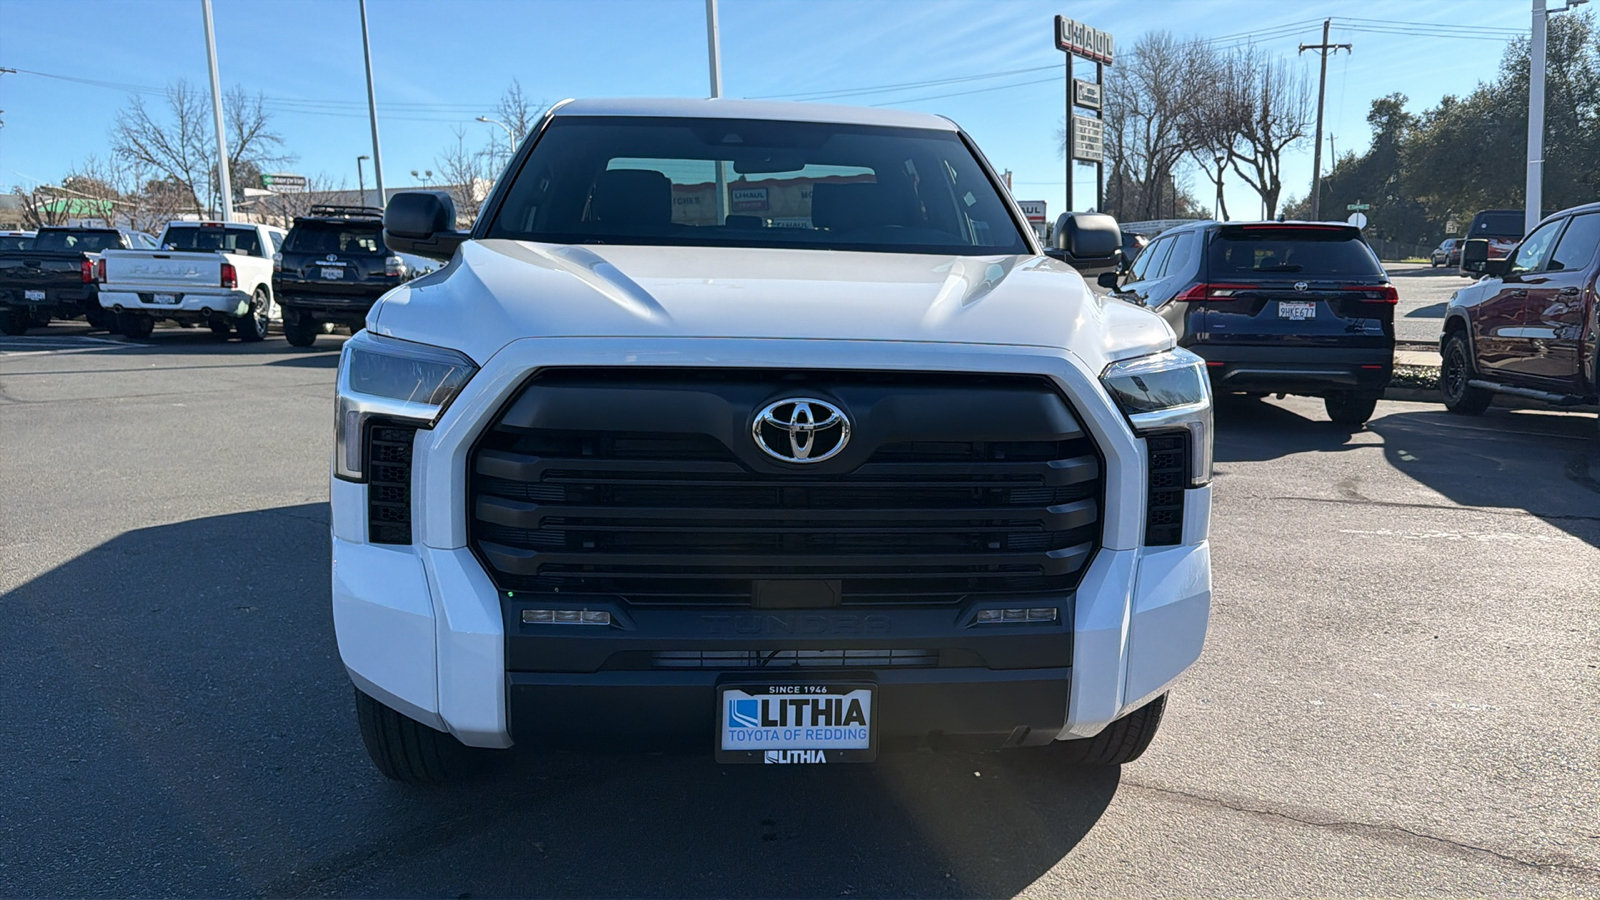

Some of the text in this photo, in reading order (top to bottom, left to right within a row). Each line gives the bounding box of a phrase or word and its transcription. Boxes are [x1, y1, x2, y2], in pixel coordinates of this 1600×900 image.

[700, 614, 892, 634] TUNDRA
[769, 686, 800, 694] SINCE
[761, 698, 867, 727] LITHIA
[728, 728, 867, 741] TOYOTA OF REDDING
[777, 750, 827, 764] LITHIA
